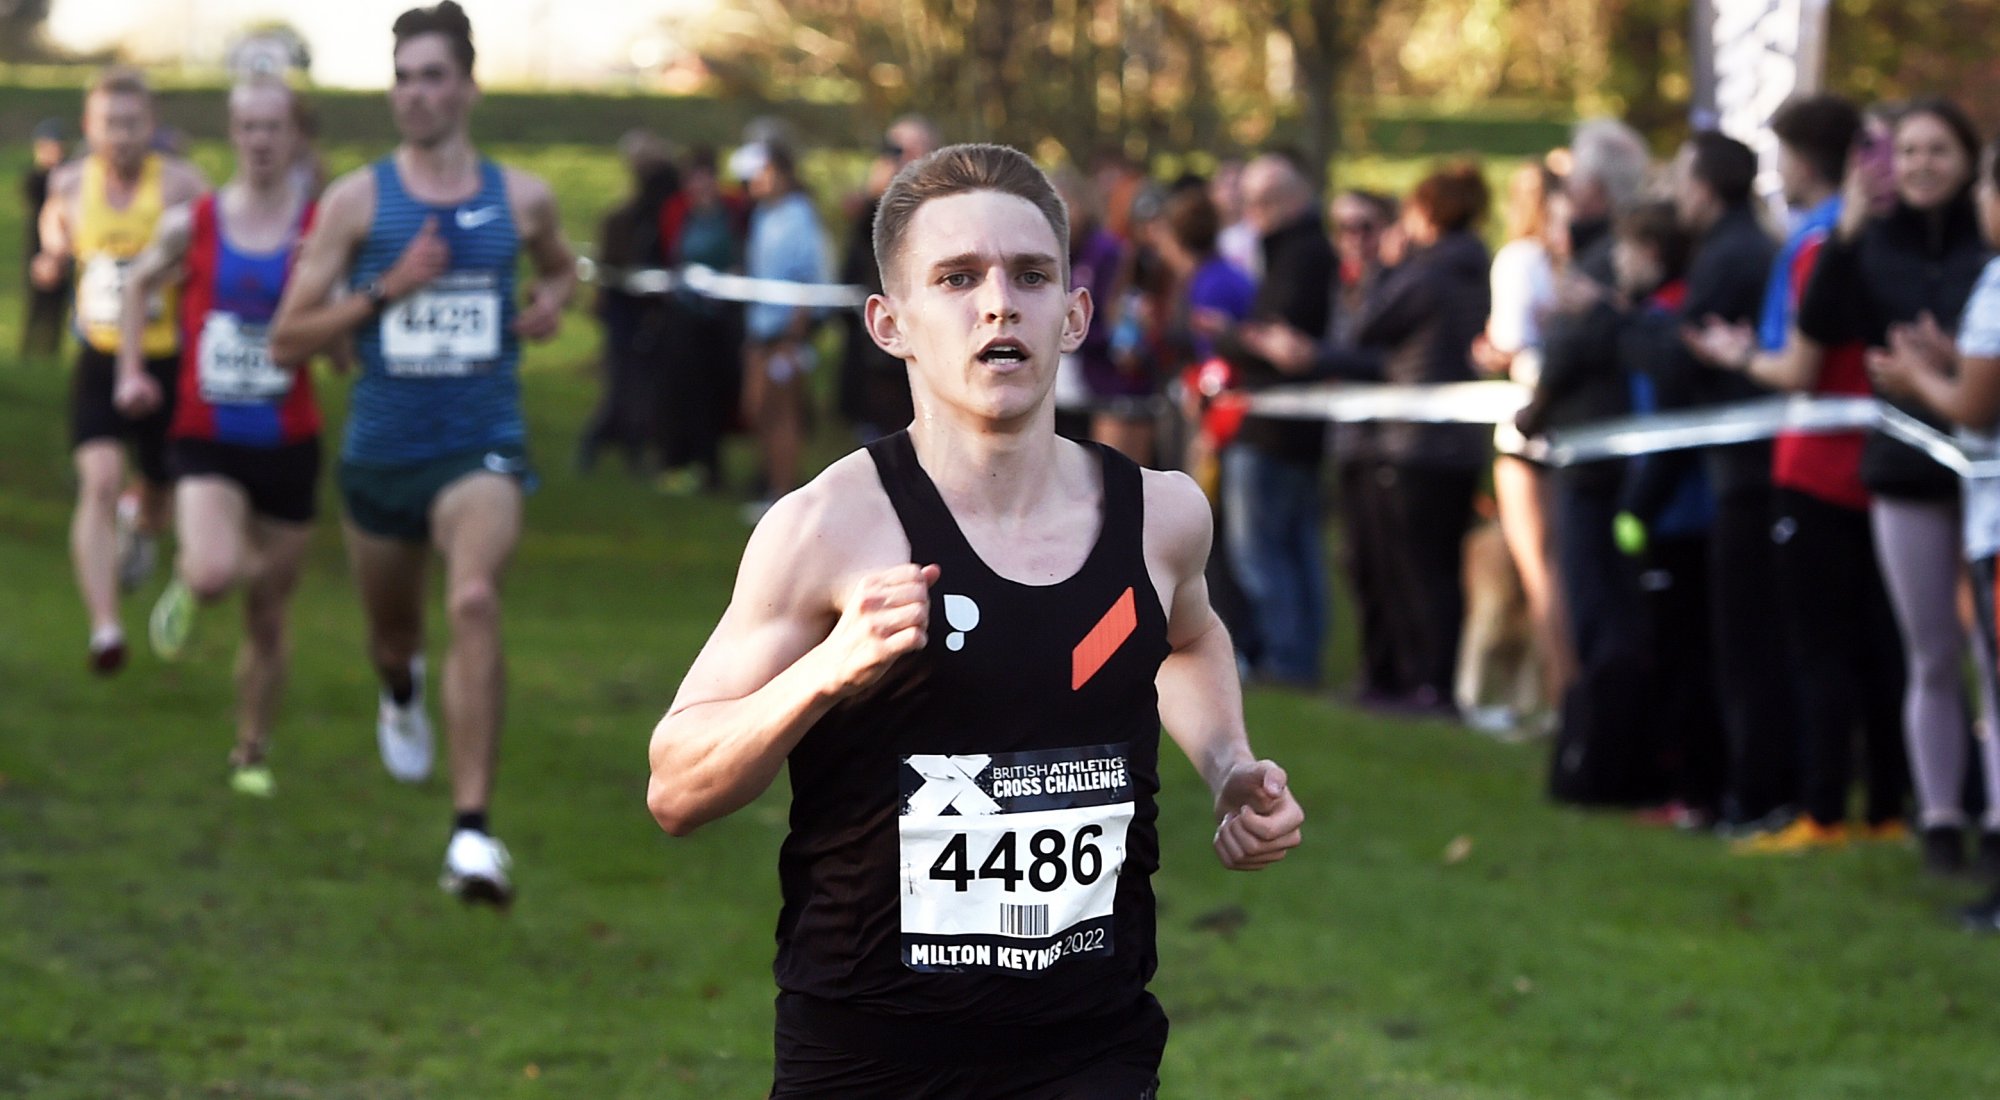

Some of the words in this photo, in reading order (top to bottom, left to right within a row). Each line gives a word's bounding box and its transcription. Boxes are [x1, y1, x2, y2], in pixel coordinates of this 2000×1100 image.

[993, 764, 1048, 780] BRITISH
[1050, 757, 1125, 776] ATHLETICS
[993, 777, 1042, 798] CROSS
[1045, 768, 1127, 795] CHALLENGE
[928, 824, 1104, 893] 4486
[911, 944, 991, 965] MILTON
[997, 941, 1063, 971] KEYNES
[1062, 927, 1105, 956] 2022
